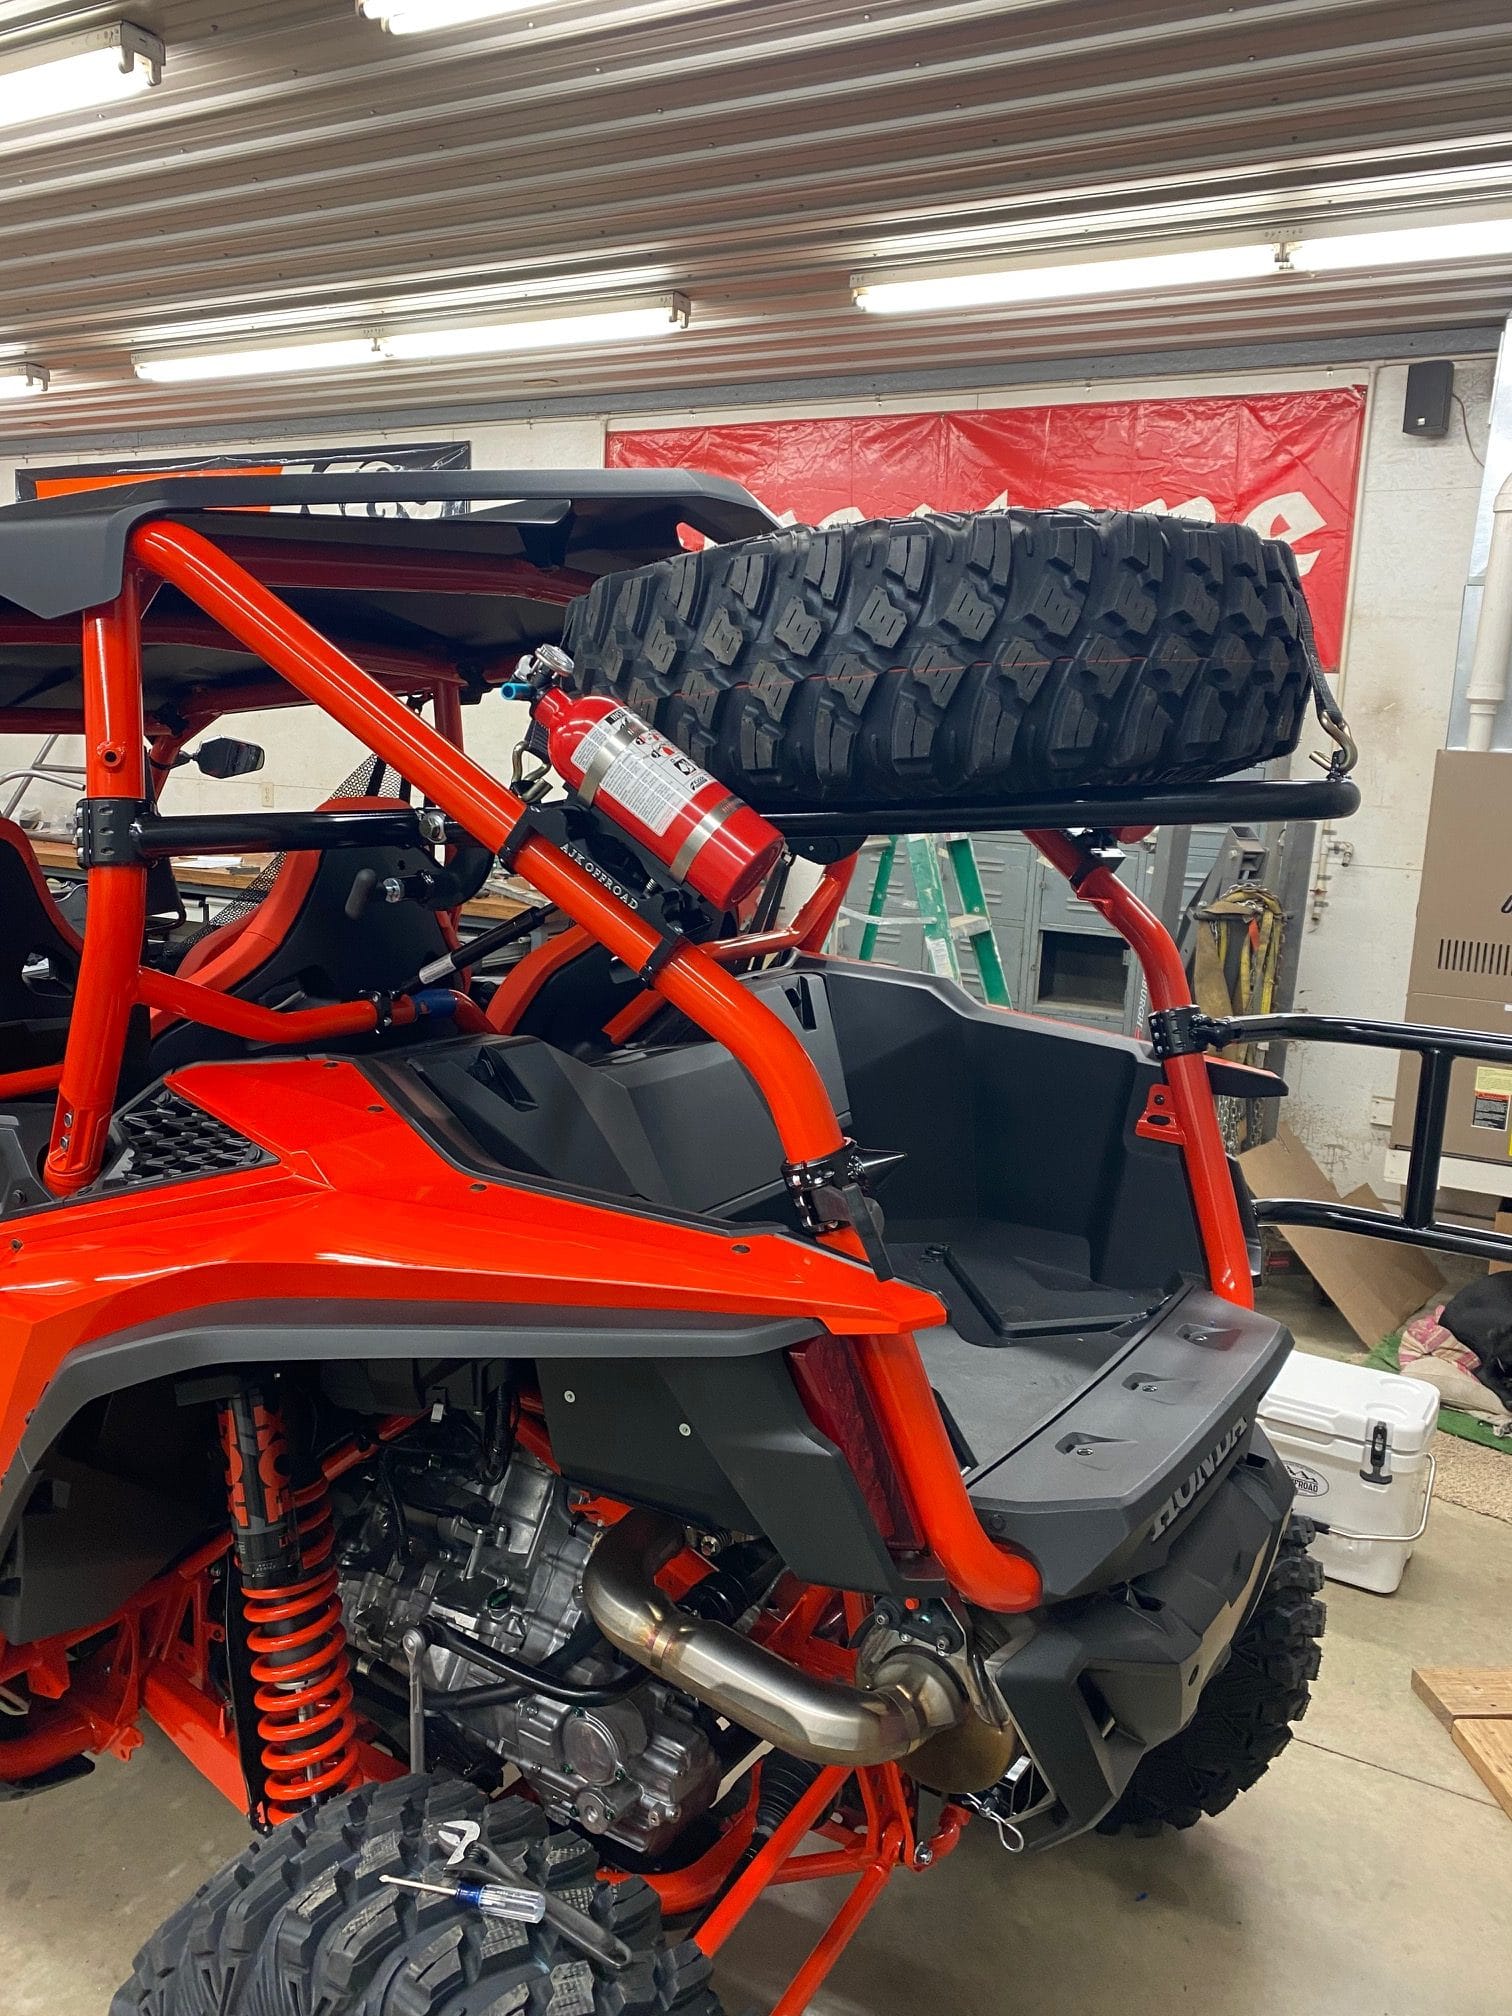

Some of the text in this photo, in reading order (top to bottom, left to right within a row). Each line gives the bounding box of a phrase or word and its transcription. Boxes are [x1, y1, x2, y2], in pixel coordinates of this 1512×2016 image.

[559, 843, 639, 910] AJK OFFROAD
[1136, 973, 1148, 1028] BURGH
